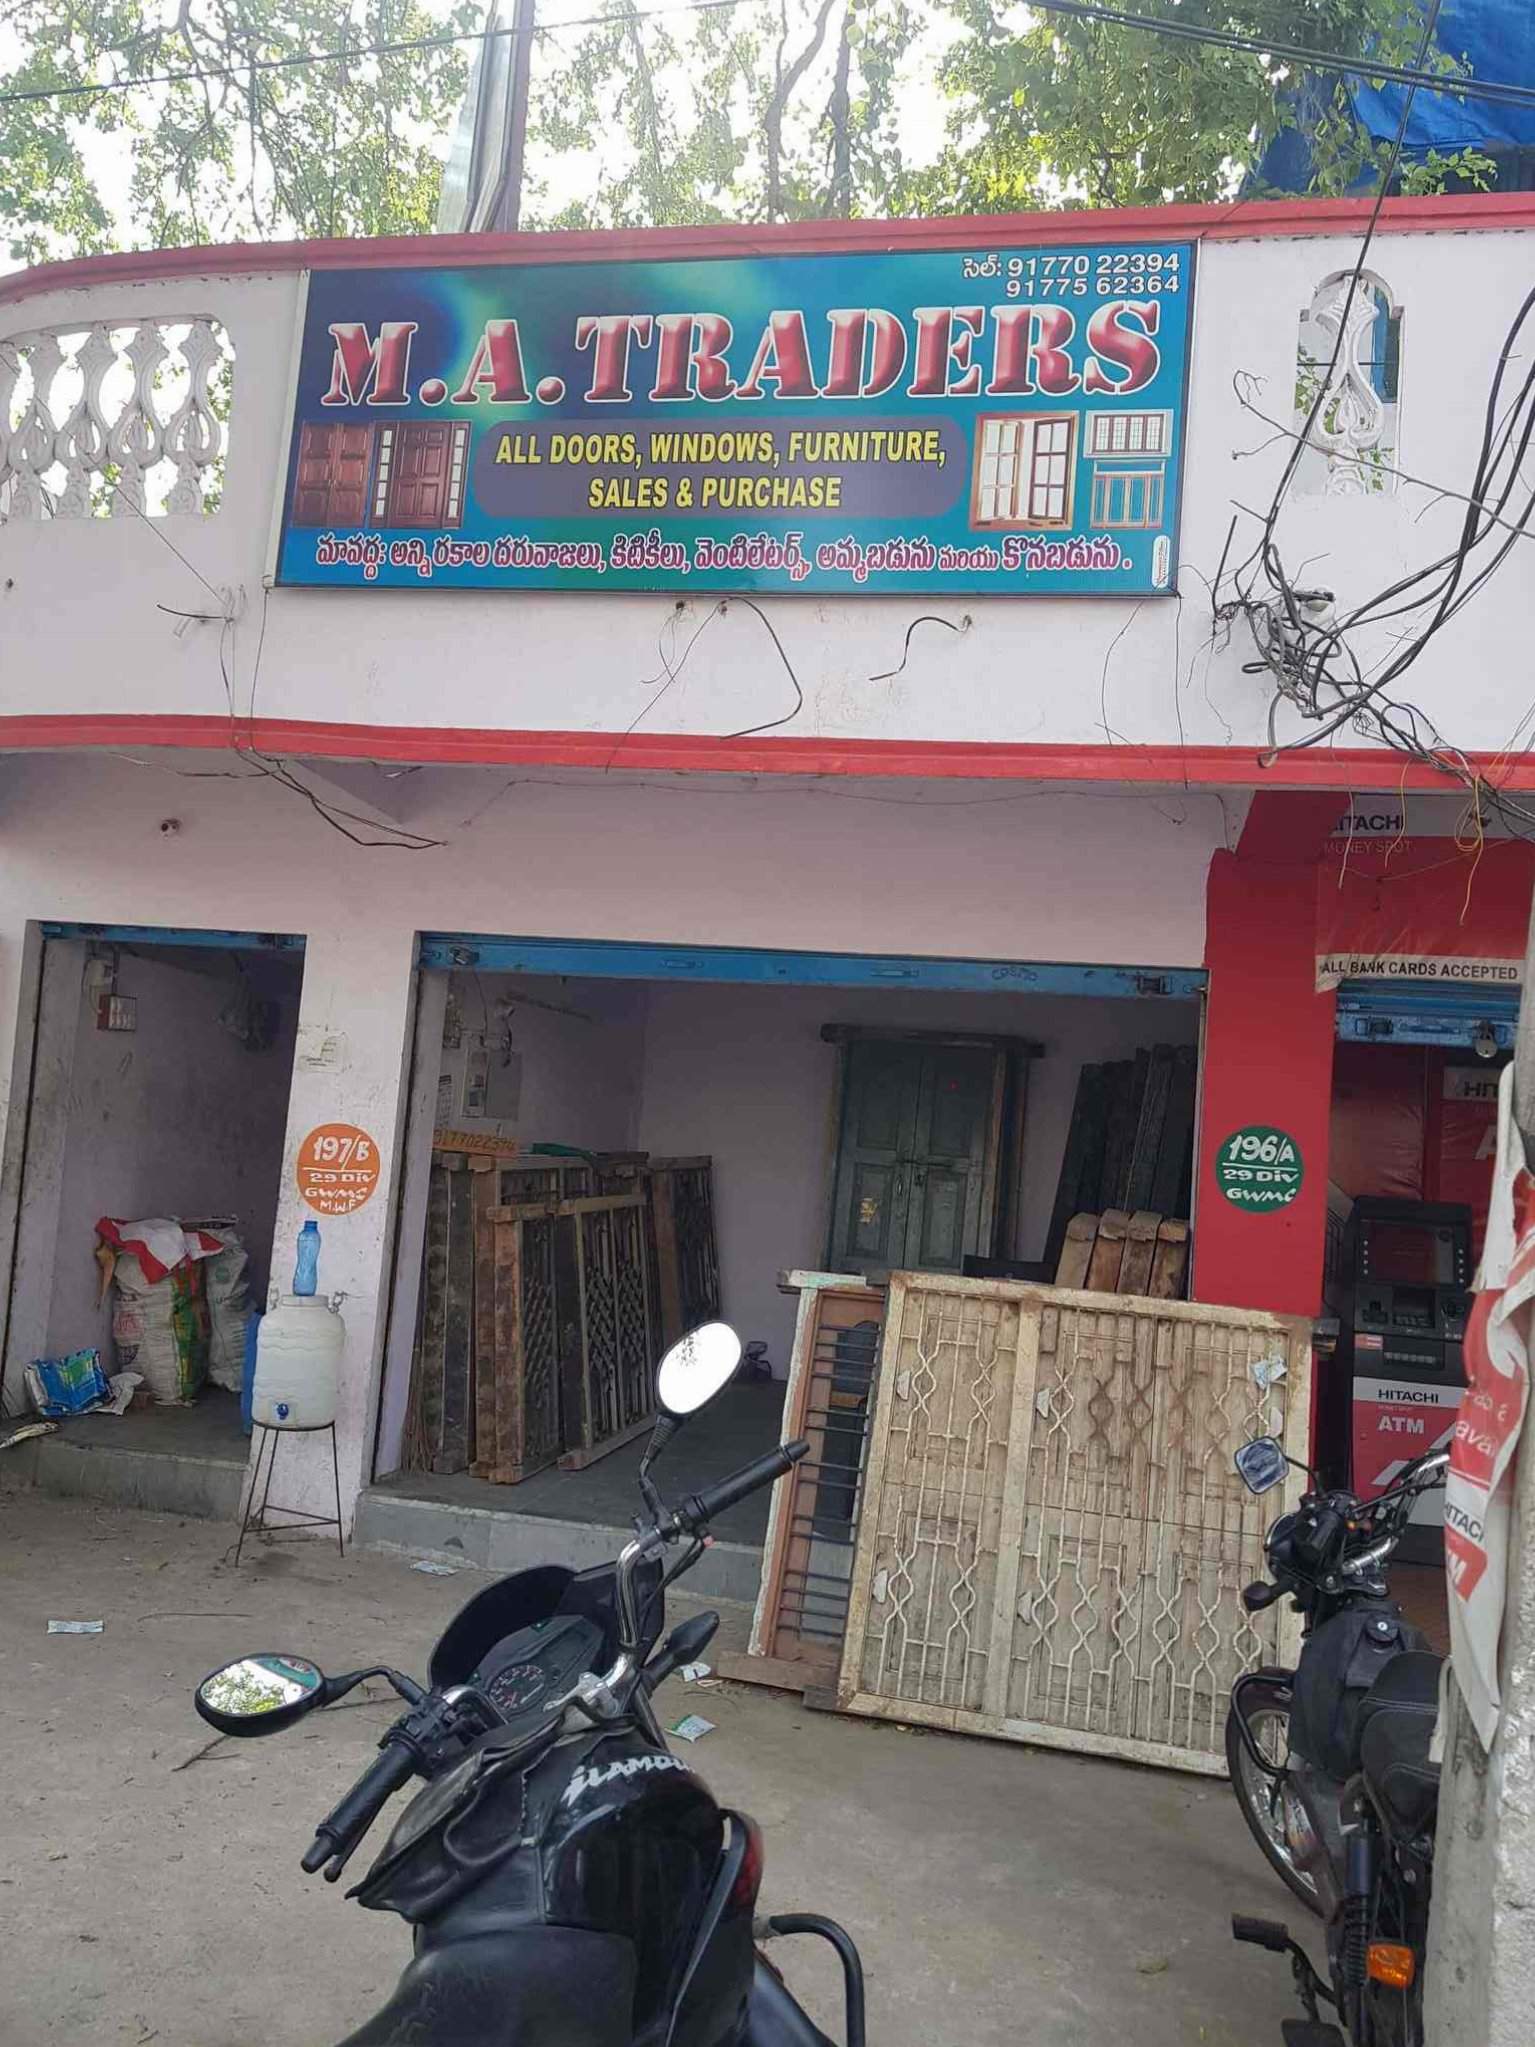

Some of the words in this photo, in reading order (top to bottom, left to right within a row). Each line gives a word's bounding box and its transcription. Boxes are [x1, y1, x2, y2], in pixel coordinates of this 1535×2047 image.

[1007, 255, 1090, 277] 91770
[1096, 253, 1179, 273] 22394
[1006, 277, 1088, 297] 91775
[1096, 275, 1179, 294] 62364
[575, 301, 1160, 404] TRADERS
[494, 434, 541, 464] ALL
[550, 433, 642, 468] DOORS,
[650, 431, 779, 468] WINDOWS,
[787, 430, 946, 467] FURNITURE,
[589, 478, 667, 508] SALES
[675, 478, 693, 507] &
[702, 476, 842, 508] PURCHASE
[390, 537, 432, 577] అన్ని
[433, 536, 489, 569] రకాల
[939, 545, 999, 571] మరియు
[1320, 960, 1346, 974] ALL
[1350, 961, 1386, 974] BANK
[1388, 962, 1437, 976] CARDS
[1440, 963, 1518, 980] ACCEPTED
[1229, 1135, 1295, 1165] 196/A
[1223, 1169, 1253, 1181] 29
[1226, 1187, 1297, 1202] GWMC
[1378, 1388, 1439, 1404] HITACHI
[1377, 1415, 1425, 1434] ATM
